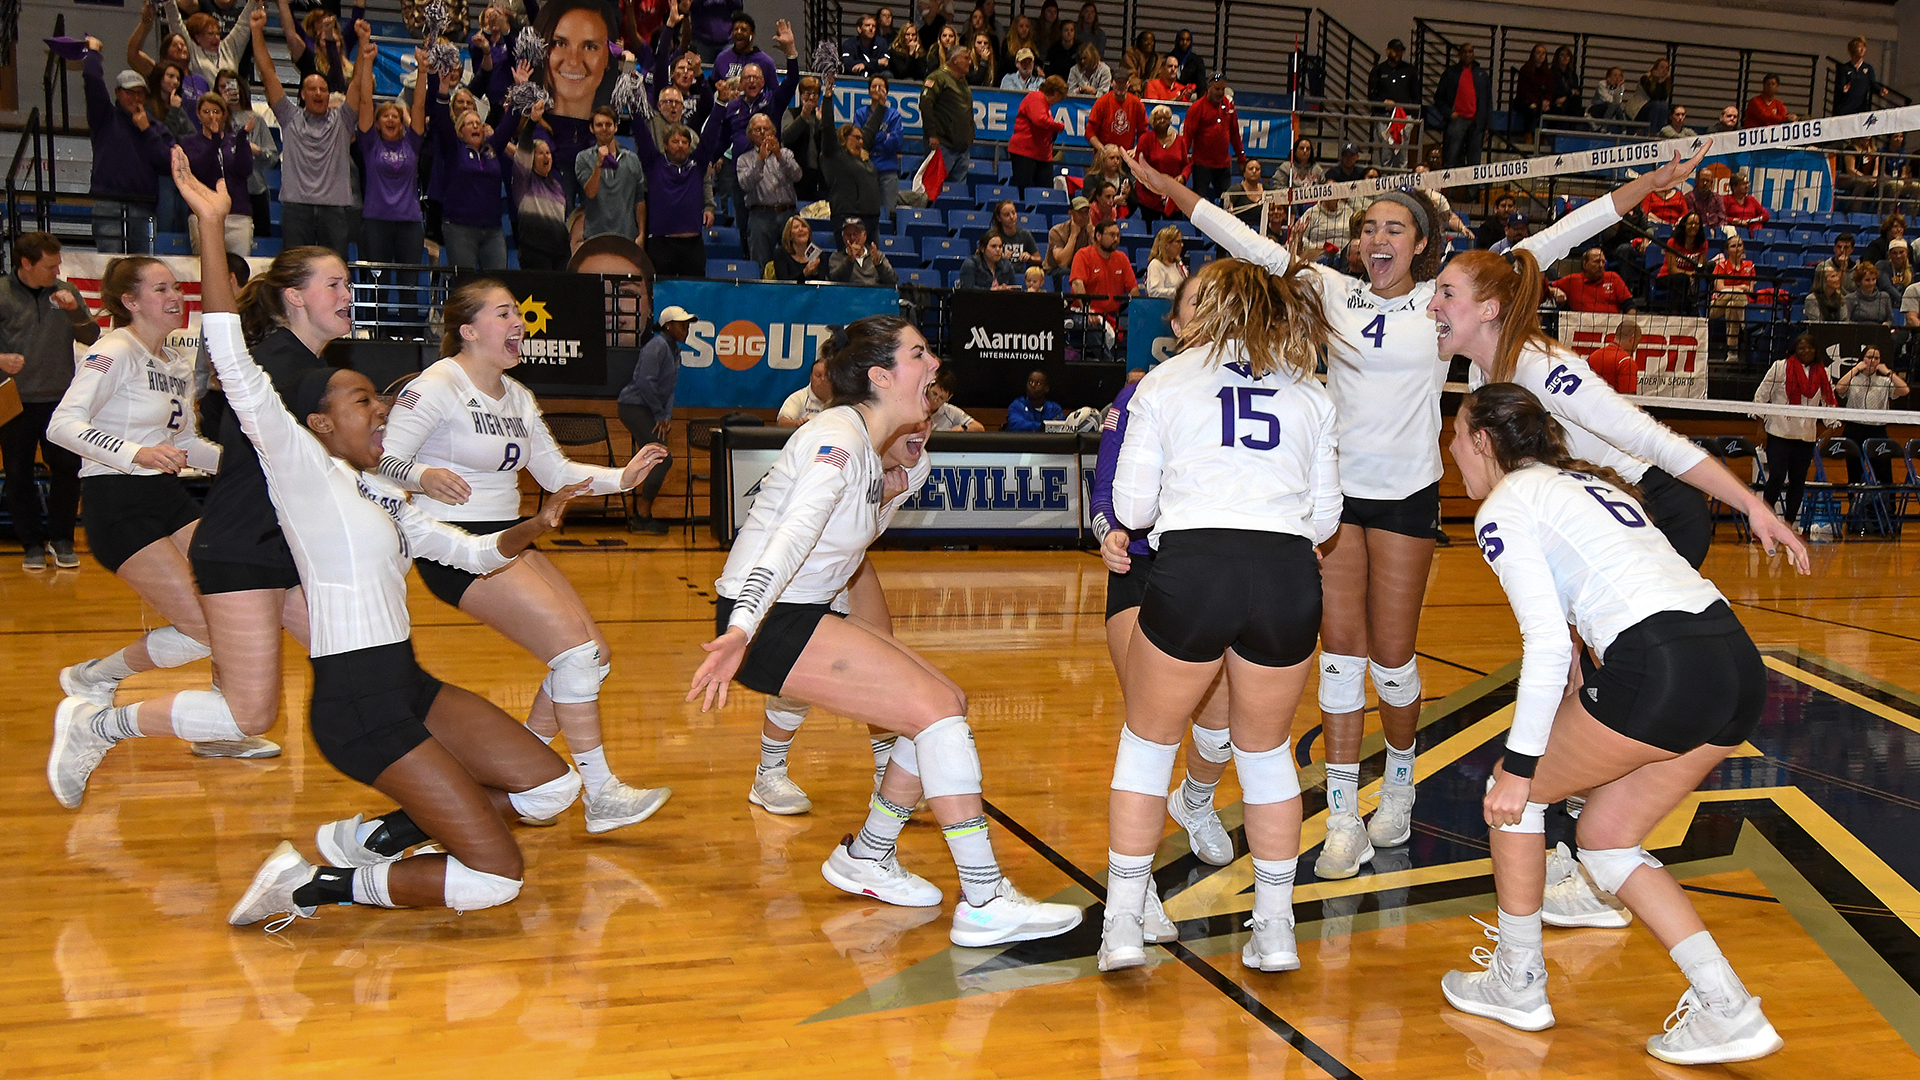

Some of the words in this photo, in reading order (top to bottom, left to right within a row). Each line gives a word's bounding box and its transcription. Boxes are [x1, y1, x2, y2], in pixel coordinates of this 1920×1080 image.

[1738, 121, 1822, 147] BULLDOGS
[1591, 144, 1659, 166] BULLDOGS
[1375, 174, 1421, 191] BULLDOGS
[1473, 162, 1528, 180] BULLDOGS
[164, 336, 200, 348] LEADE
[964, 326, 1054, 351] Marriott
[1361, 314, 1386, 348] 4
[518, 339, 581, 358] NBELT
[715, 334, 766, 356] BIG
[980, 351, 1045, 361] INTERNATIONAL
[519, 356, 567, 365] NTALS
[167, 398, 183, 430] 2
[471, 411, 505, 437] HIGH
[1216, 386, 1281, 451] 15
[497, 442, 521, 472] 8
[1584, 486, 1647, 528] 6
